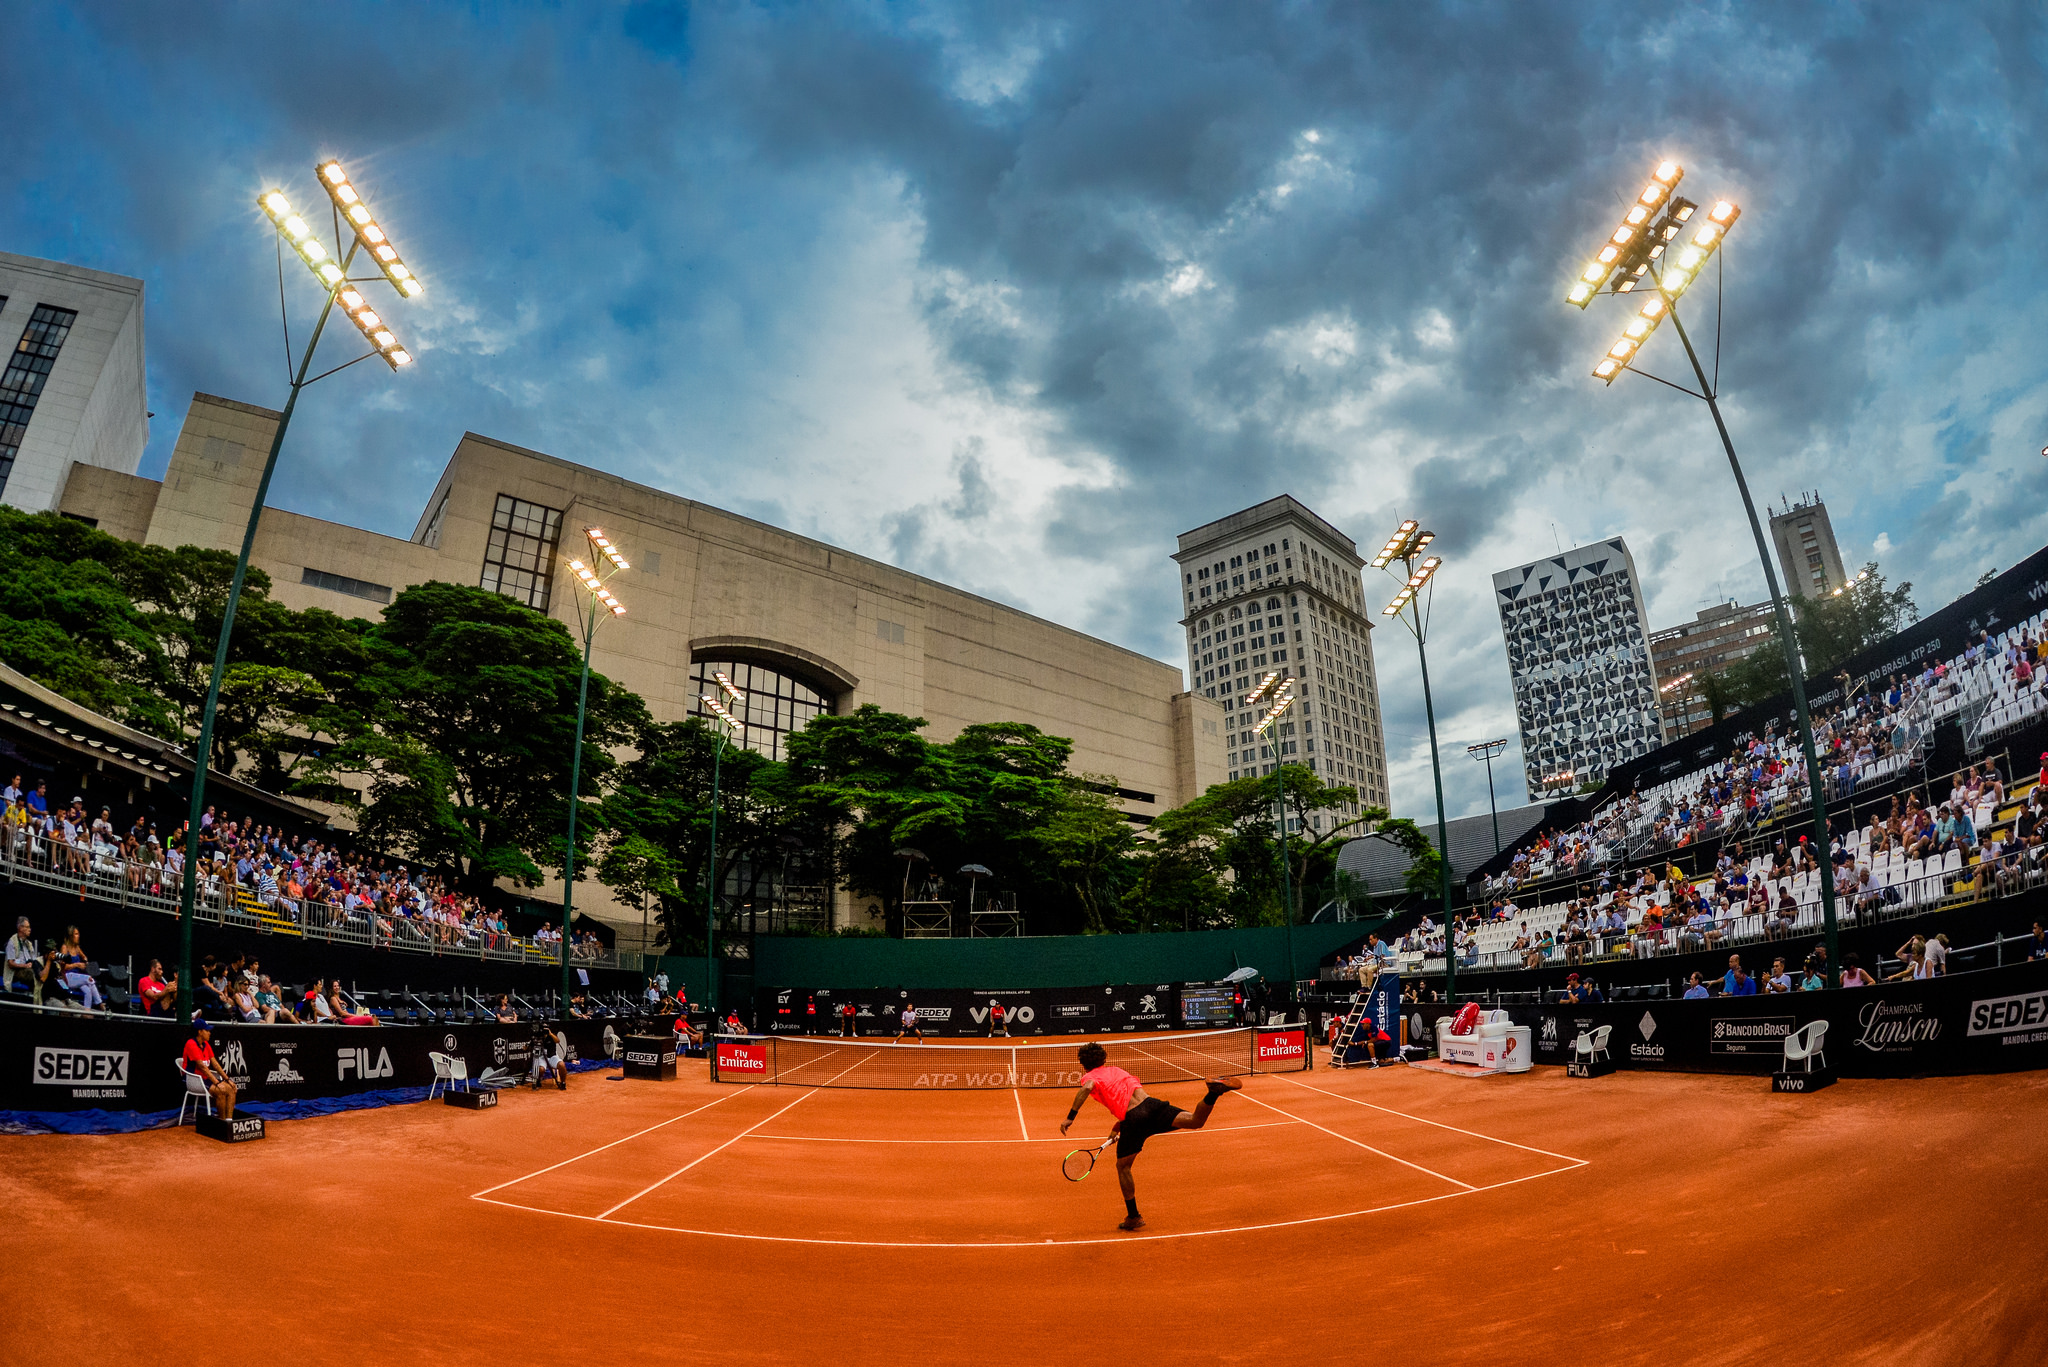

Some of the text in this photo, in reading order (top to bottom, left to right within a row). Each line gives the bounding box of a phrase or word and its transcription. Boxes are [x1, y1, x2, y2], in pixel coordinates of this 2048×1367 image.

[1809, 688, 1839, 710] TORNEIO
[1869, 668, 1881, 682] DO
[1882, 654, 1911, 677] BRASIL
[1910, 646, 1925, 662] ATP
[1926, 638, 1941, 654] 250
[1764, 717, 1780, 730] ATP
[778, 996, 790, 1004] EY
[916, 1009, 949, 1017] SEDEX
[969, 999, 1035, 1024] vivo
[1878, 1003, 1923, 1016] CHAMPAGNE
[1764, 1023, 1791, 1036] BRASIL
[1853, 1000, 1943, 1051] Lanson
[1275, 1038, 1288, 1046] Fly
[1726, 1044, 1746, 1053] Seguros
[734, 1049, 748, 1058] Fly
[1260, 1045, 1302, 1056] Emirates
[1461, 1049, 1475, 1057] ARTOIS
[1630, 1043, 1665, 1056] Estácio
[628, 1053, 656, 1061] SEDEX
[663, 1053, 676, 1062] SEDEX
[719, 1056, 764, 1069] Emirates
[37, 1052, 125, 1081] SEDEX
[337, 1046, 394, 1082] FILA
[1568, 1064, 1589, 1077] FILA
[265, 1070, 304, 1082] BRASIL
[914, 1070, 1083, 1087] ATP WORLD TO
[1779, 1075, 1804, 1090] vivo
[479, 1092, 497, 1107] FILA
[232, 1119, 262, 1134] PACTO
